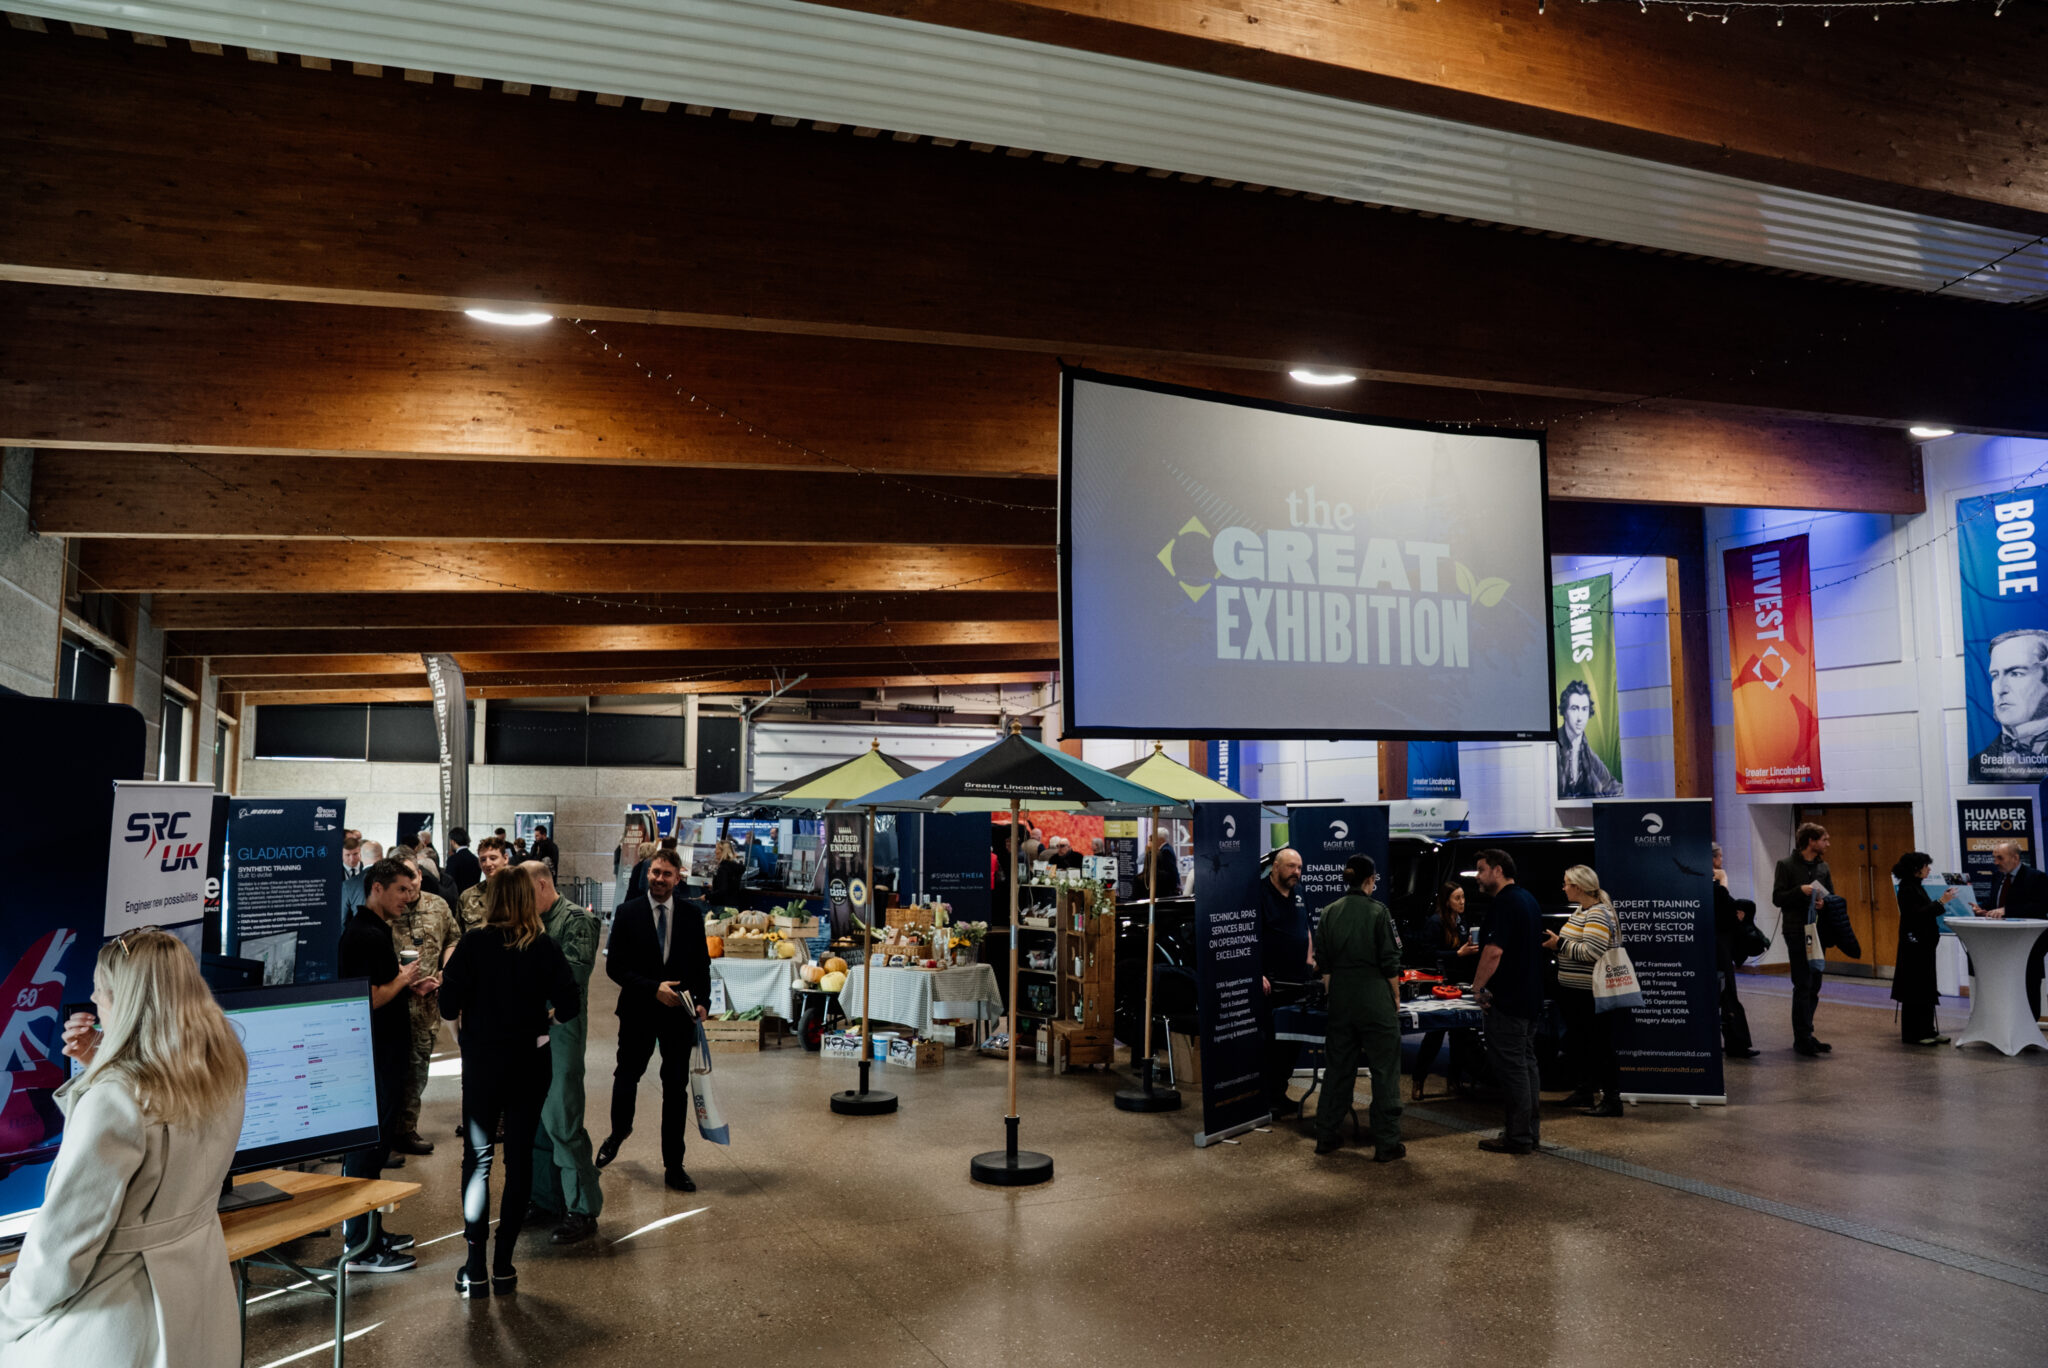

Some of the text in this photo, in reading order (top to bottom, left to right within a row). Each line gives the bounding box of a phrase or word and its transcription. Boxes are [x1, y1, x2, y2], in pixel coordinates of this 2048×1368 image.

[1285, 485, 1355, 531] the
[1994, 499, 2038, 596] BOOLE
[1212, 525, 1450, 593] GREAT
[1751, 550, 1785, 642] INVEST
[1216, 585, 1469, 668] EXHIBITION
[1568, 585, 1594, 664] BANKS
[1980, 753, 2015, 765] Greater
[964, 782, 1063, 792] Greater Lincolnshire
[1964, 808, 2026, 820] HUMBER
[124, 811, 191, 843] SRC
[1965, 820, 2027, 831] FREEPORT
[833, 835, 858, 843] ALFRED
[1344, 840, 1356, 848] EYE
[238, 846, 315, 861] GLADIATOR
[830, 844, 861, 853] ENDERBY
[160, 843, 203, 872] UK
[238, 864, 302, 873] SYNTHETIC TRAINING
[1306, 864, 1347, 872] ENABLIN
[1301, 874, 1324, 882] RPAS
[830, 888, 847, 897] taste
[1305, 884, 1323, 892] FOR
[1325, 884, 1343, 892] THE
[125, 892, 198, 914] Engineer new possibilities
[1612, 900, 1700, 908] EXPERT TRAINING
[1209, 909, 1256, 923] TECHNICAL RPAS
[1618, 911, 1695, 920] EVERY MISSION
[1211, 922, 1255, 936] SERVICES BUILT
[1620, 923, 1694, 931] EVERY SECTOR
[1208, 934, 1258, 949] ON OPERATIONAL
[1621, 934, 1694, 943] EVERY SYSTEM
[1215, 947, 1252, 961] EXCELLENCE
[1652, 980, 1677, 988] Training
[1635, 1017, 1660, 1025] Imagery
